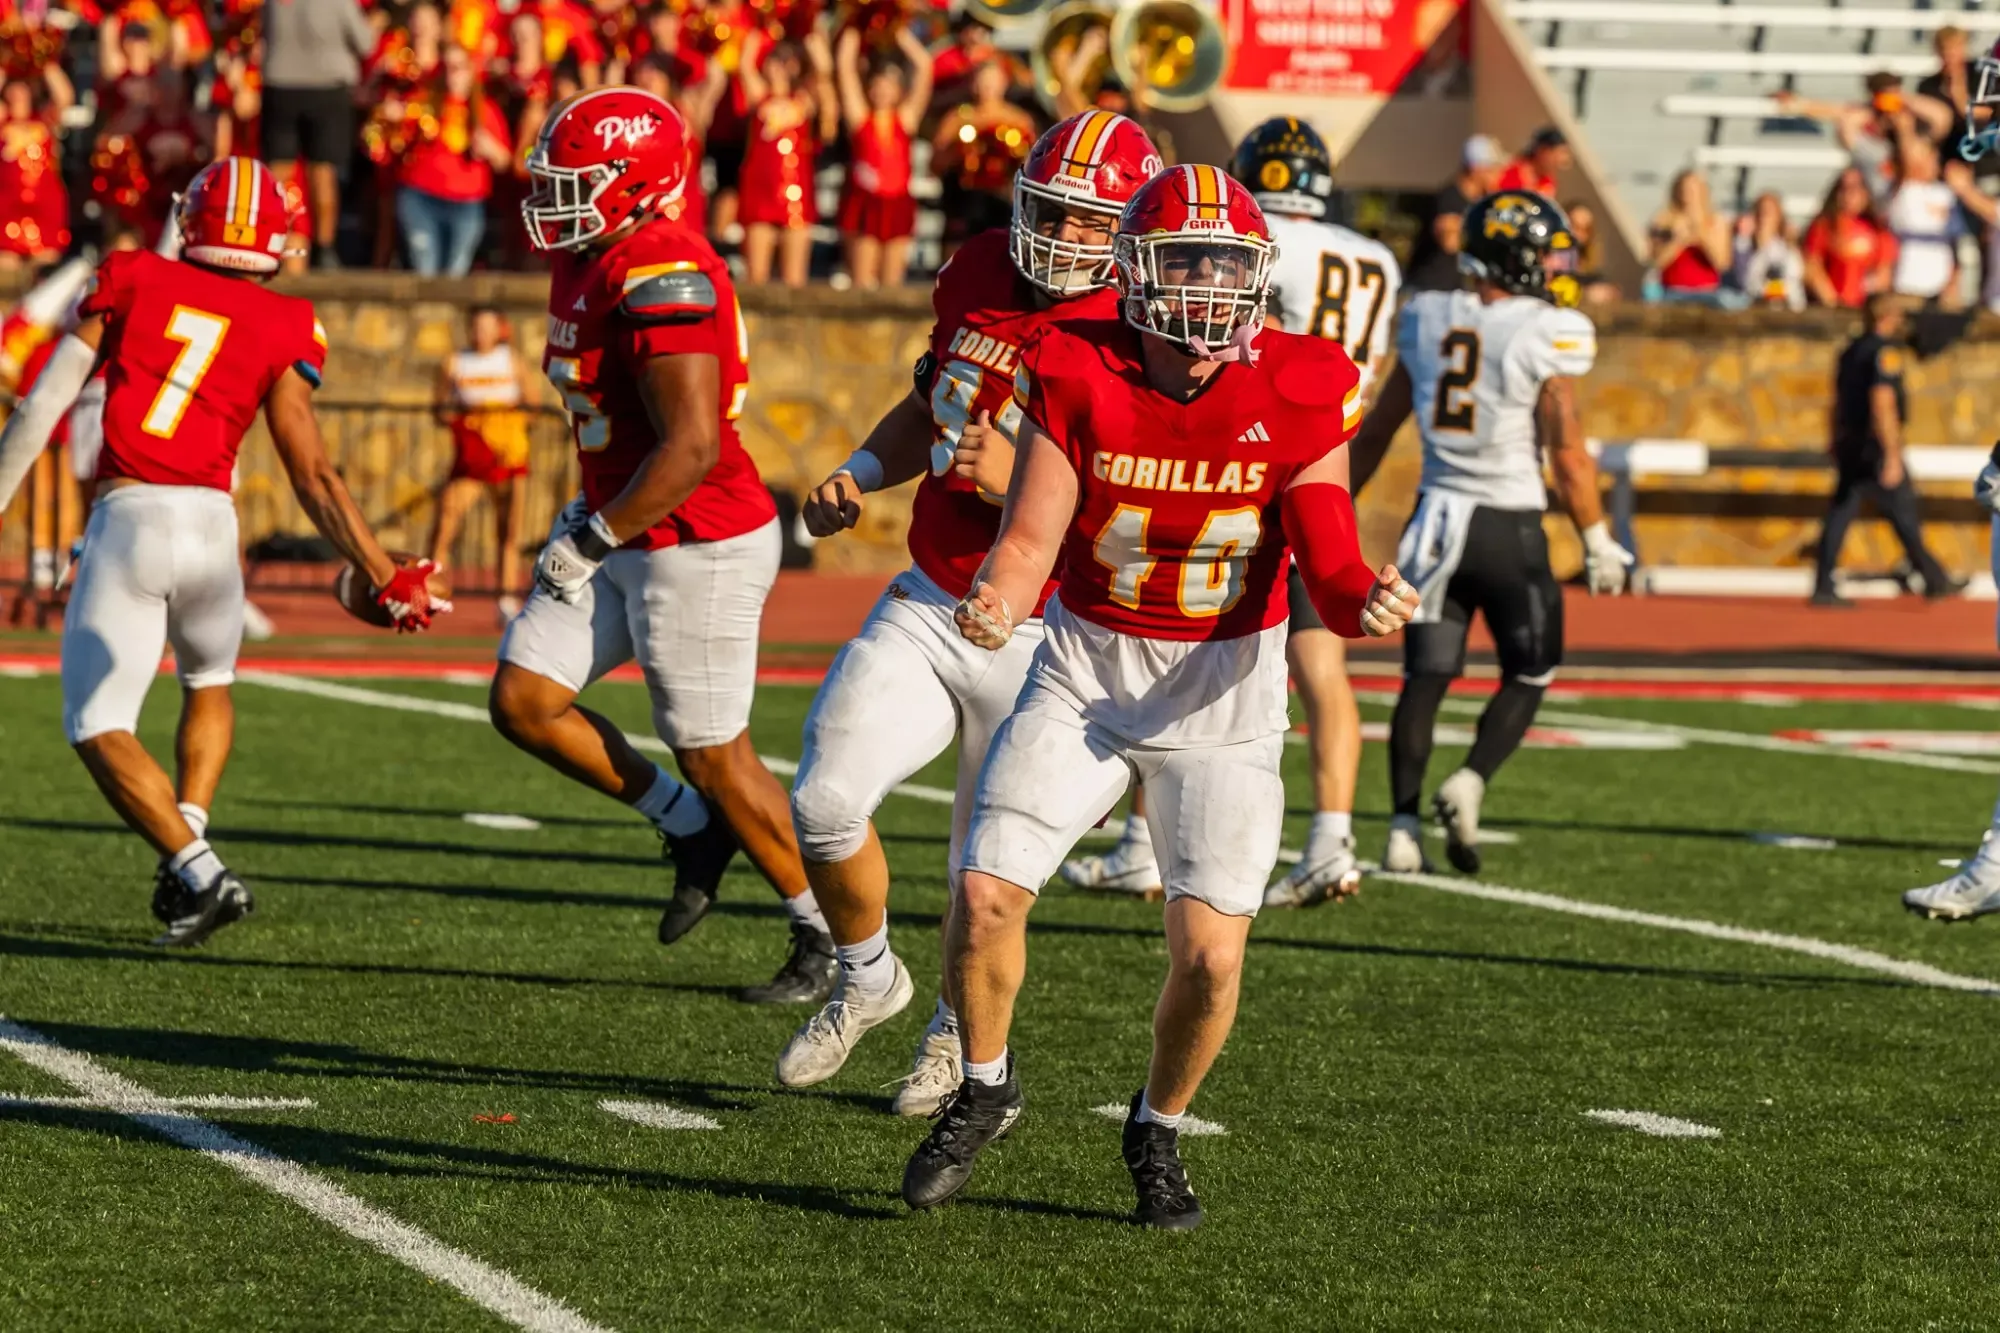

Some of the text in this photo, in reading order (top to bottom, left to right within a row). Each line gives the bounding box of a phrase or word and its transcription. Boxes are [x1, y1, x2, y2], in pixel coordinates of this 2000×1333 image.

[593, 113, 657, 152] Pitt
[1054, 175, 1090, 191] Riddell
[1189, 219, 1227, 231] GRIT
[1307, 250, 1387, 364] 87
[141, 304, 231, 440] 7
[1433, 325, 1482, 432] 2
[1093, 450, 1268, 493] GORILLAS
[1093, 502, 1265, 618] 40
